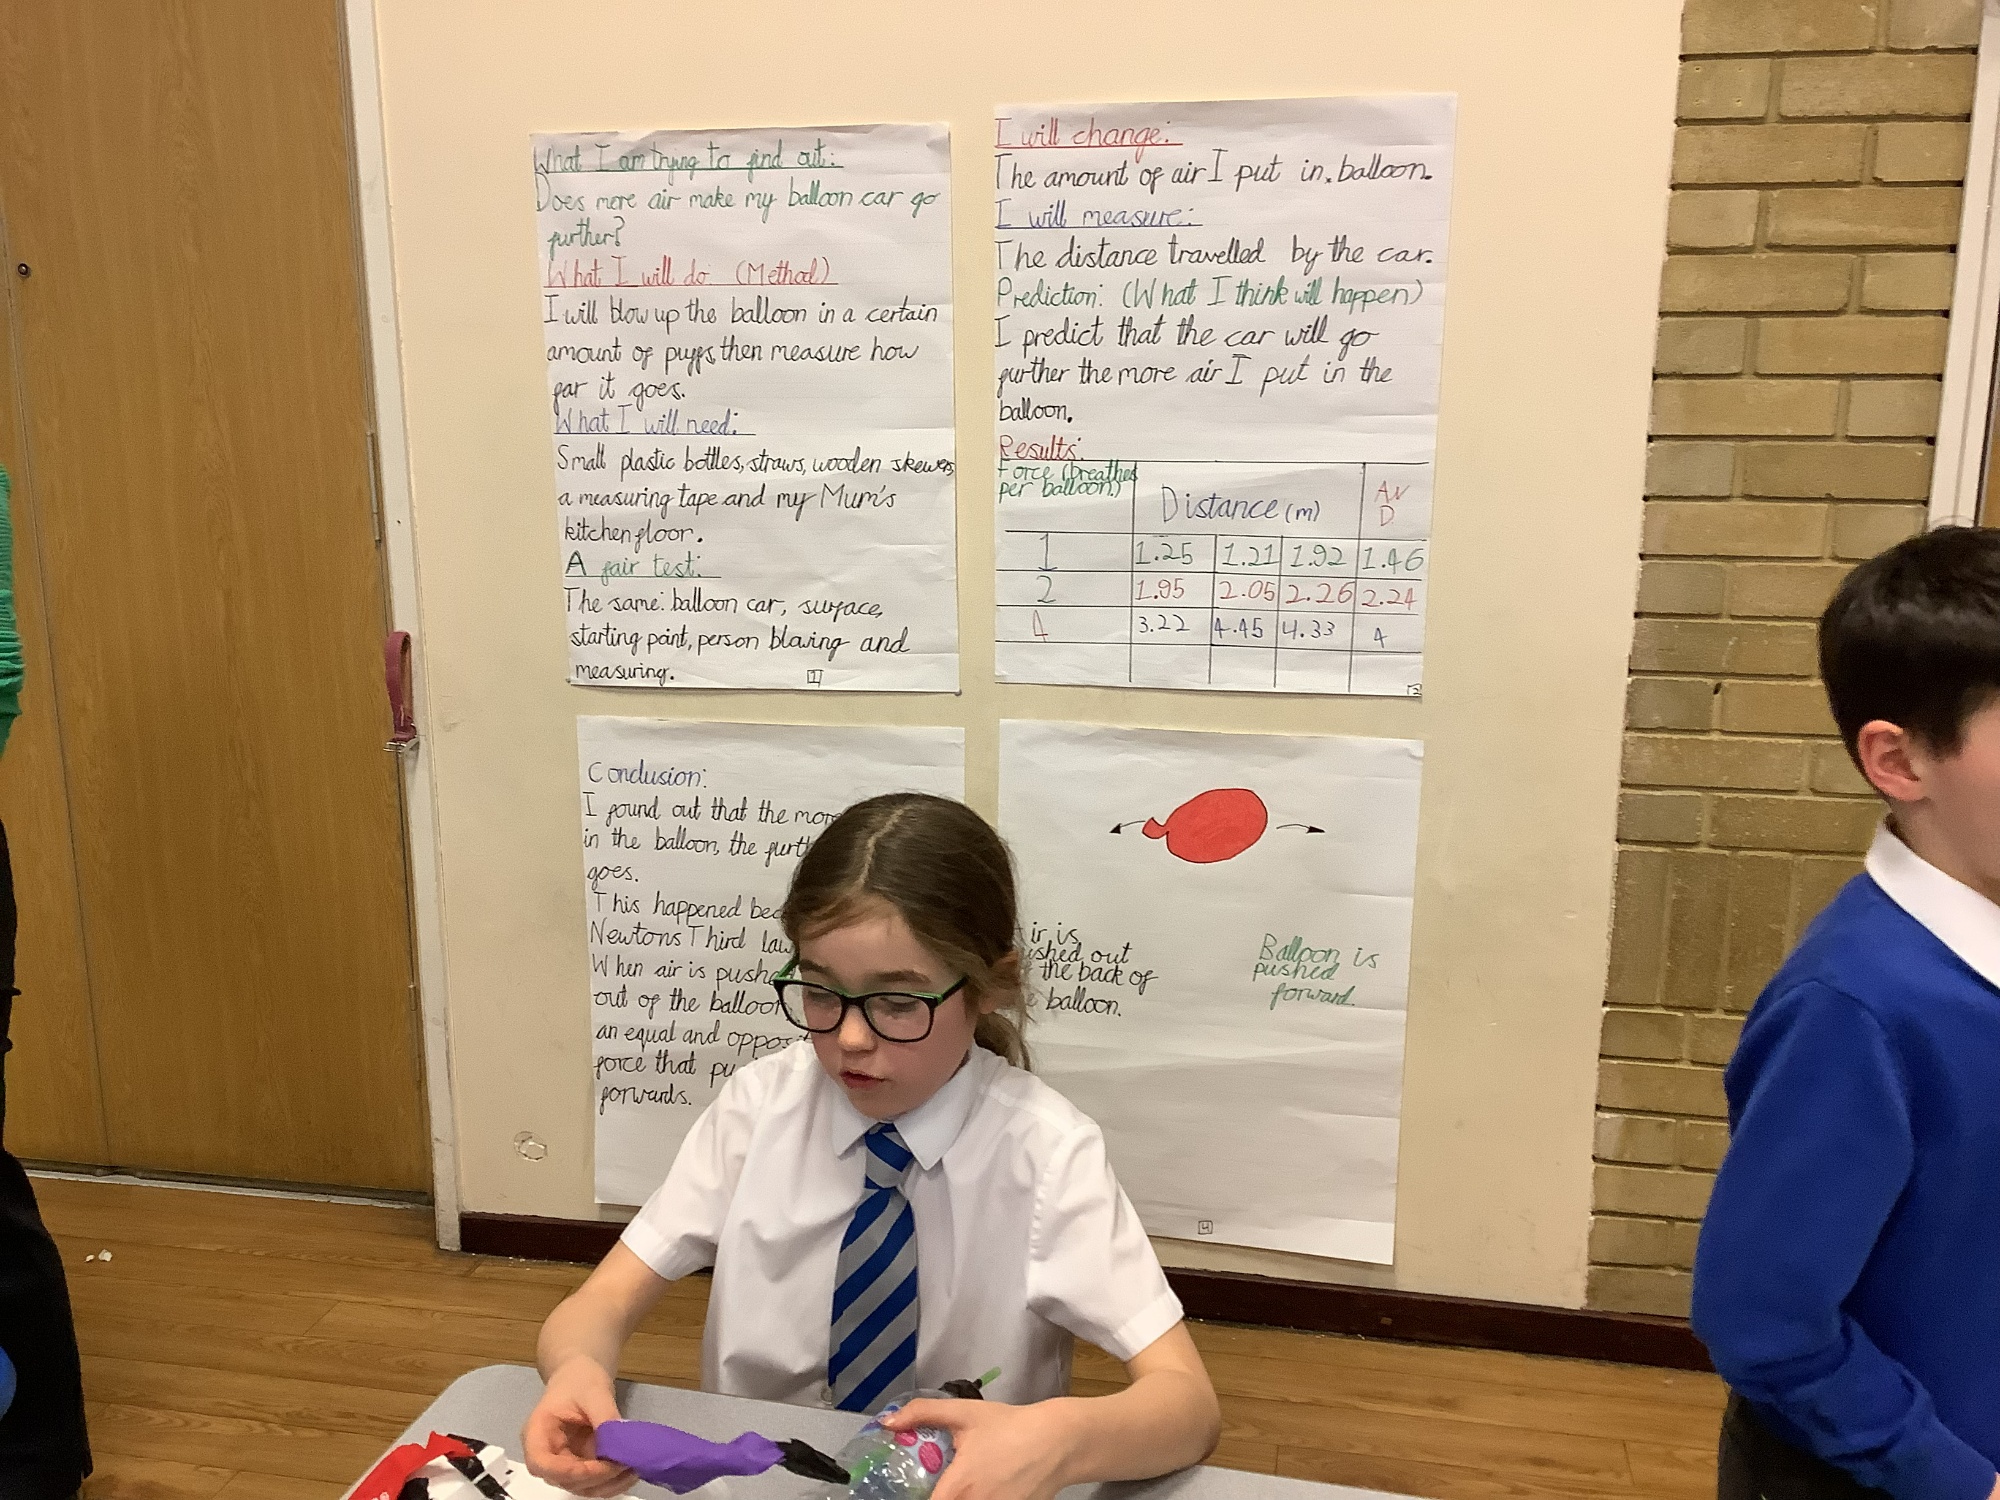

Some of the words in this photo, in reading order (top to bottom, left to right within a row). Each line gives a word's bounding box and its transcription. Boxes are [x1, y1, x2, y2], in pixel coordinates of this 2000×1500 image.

[994, 118, 1012, 146] I
[1022, 117, 1059, 145] will
[1072, 117, 1170, 163] change:
[534, 144, 582, 173] What
[618, 152, 646, 170] am
[706, 141, 731, 169] to
[747, 139, 783, 182] find
[994, 154, 1036, 189] The
[1044, 160, 1128, 188] amount
[1139, 166, 1164, 193] of
[1171, 159, 1207, 184] air
[1207, 148, 1227, 182] I
[1235, 154, 1281, 191] put
[1338, 154, 1432, 182] balloon.
[534, 173, 585, 212] Does
[648, 191, 682, 209] air
[690, 186, 736, 208] make
[746, 194, 778, 223] my
[788, 176, 852, 207] balloon
[861, 191, 903, 206] car
[911, 192, 940, 218] go
[995, 199, 1012, 227] I
[1029, 199, 1067, 227] will
[1083, 207, 1194, 227] measure:
[547, 216, 625, 260] further?
[994, 240, 1047, 270] The
[1056, 235, 1157, 268] distance
[1169, 234, 1264, 264] travelled
[1291, 235, 1323, 275] by
[1328, 235, 1363, 263] the
[1377, 244, 1432, 264] car.
[548, 258, 602, 286] What
[642, 255, 674, 286] will
[998, 278, 1103, 308] Prediction:
[1124, 279, 1197, 309] (What
[1207, 276, 1232, 306] I
[1236, 278, 1289, 306] think
[1294, 278, 1322, 306] will
[1331, 278, 1424, 314] happen)
[544, 295, 559, 323] I
[564, 298, 597, 324] will
[611, 297, 651, 324] blow
[655, 308, 680, 334] up
[685, 297, 716, 324] the
[732, 295, 808, 324] balloon
[819, 303, 836, 323] in
[866, 296, 938, 324] certain
[547, 337, 621, 363] amount
[633, 346, 654, 367] of
[720, 336, 763, 360] then
[771, 343, 860, 361] measure
[872, 336, 919, 360] how
[994, 315, 1010, 347] I
[1022, 316, 1103, 358] predict
[1117, 315, 1166, 346] that
[1177, 314, 1216, 345] the
[1224, 328, 1278, 347] car
[1284, 315, 1328, 345] will
[1340, 329, 1379, 360] go
[552, 381, 587, 412] far
[599, 371, 615, 400] it
[628, 384, 685, 411] goes.
[998, 358, 1070, 398] further
[1078, 358, 1113, 384] the
[1186, 358, 1224, 383] air
[1225, 354, 1251, 384] I
[1262, 356, 1309, 397] put
[1324, 361, 1344, 383] in
[1359, 357, 1392, 384] the
[556, 407, 611, 434] What
[645, 407, 678, 434] will
[999, 397, 1072, 423] balloon.
[558, 442, 605, 471] Small
[621, 447, 675, 481] plastic
[685, 446, 744, 473] bottles,
[747, 449, 807, 475] straws,
[813, 447, 881, 473] wooden
[580, 490, 675, 519] measuring
[678, 483, 717, 514] tape
[722, 483, 766, 508] and
[777, 493, 818, 521] my
[820, 483, 896, 508] Mum's
[999, 481, 1034, 503] per
[1162, 484, 1289, 522] Distance
[1285, 499, 1320, 523] (m)
[564, 516, 631, 543] kitchen
[634, 518, 703, 553] floor.
[1039, 533, 1058, 572] 1
[1135, 541, 1193, 565] 1.25
[1224, 542, 1279, 567] 1.21
[1290, 545, 1347, 568] 1.92
[1362, 546, 1424, 574] 1.46
[566, 551, 587, 576] A
[600, 558, 640, 586] fair
[653, 551, 701, 577] test:
[564, 587, 600, 613] The
[671, 586, 737, 614] balloon
[747, 597, 786, 617] car,
[1036, 575, 1056, 604] 2
[1220, 581, 1276, 601] 2.05
[1286, 582, 1354, 604] 2.26
[1362, 588, 1417, 610] 2.24
[1139, 614, 1190, 633] 3.22
[1282, 620, 1336, 639] 4.33
[1374, 628, 1387, 648] 4
[570, 624, 642, 656] starting
[697, 635, 759, 657] person
[860, 627, 910, 654] and
[576, 663, 675, 686] measuring.
[588, 759, 707, 788] Conclusion:
[582, 791, 597, 817] I
[606, 796, 661, 826] found
[672, 796, 701, 819] out
[711, 796, 747, 821] that
[758, 799, 789, 824] the
[583, 828, 598, 848] in
[612, 827, 641, 850] the
[654, 825, 720, 855] balloon,
[728, 830, 757, 855] the
[587, 864, 638, 890] goes.
[594, 892, 640, 913] This
[653, 891, 741, 924] happened
[590, 918, 682, 946] Newtons
[688, 925, 746, 951] Third
[1057, 922, 1080, 944] is
[593, 954, 643, 978] When
[654, 960, 683, 977] air
[1091, 943, 1132, 963] out
[1259, 933, 1340, 963] Balloon
[1353, 948, 1379, 968] is
[1039, 960, 1073, 980] the
[1079, 961, 1125, 985] back
[1129, 970, 1158, 995] of
[1253, 962, 1340, 982] pushed
[594, 984, 628, 1008] out
[638, 993, 661, 1019] of
[670, 988, 700, 1012] the
[1046, 986, 1121, 1017] balloon.
[624, 1020, 677, 1051] equal
[683, 1020, 720, 1045] and
[594, 1056, 647, 1079] force
[655, 1050, 697, 1075] that
[600, 1083, 691, 1115] forwards.
